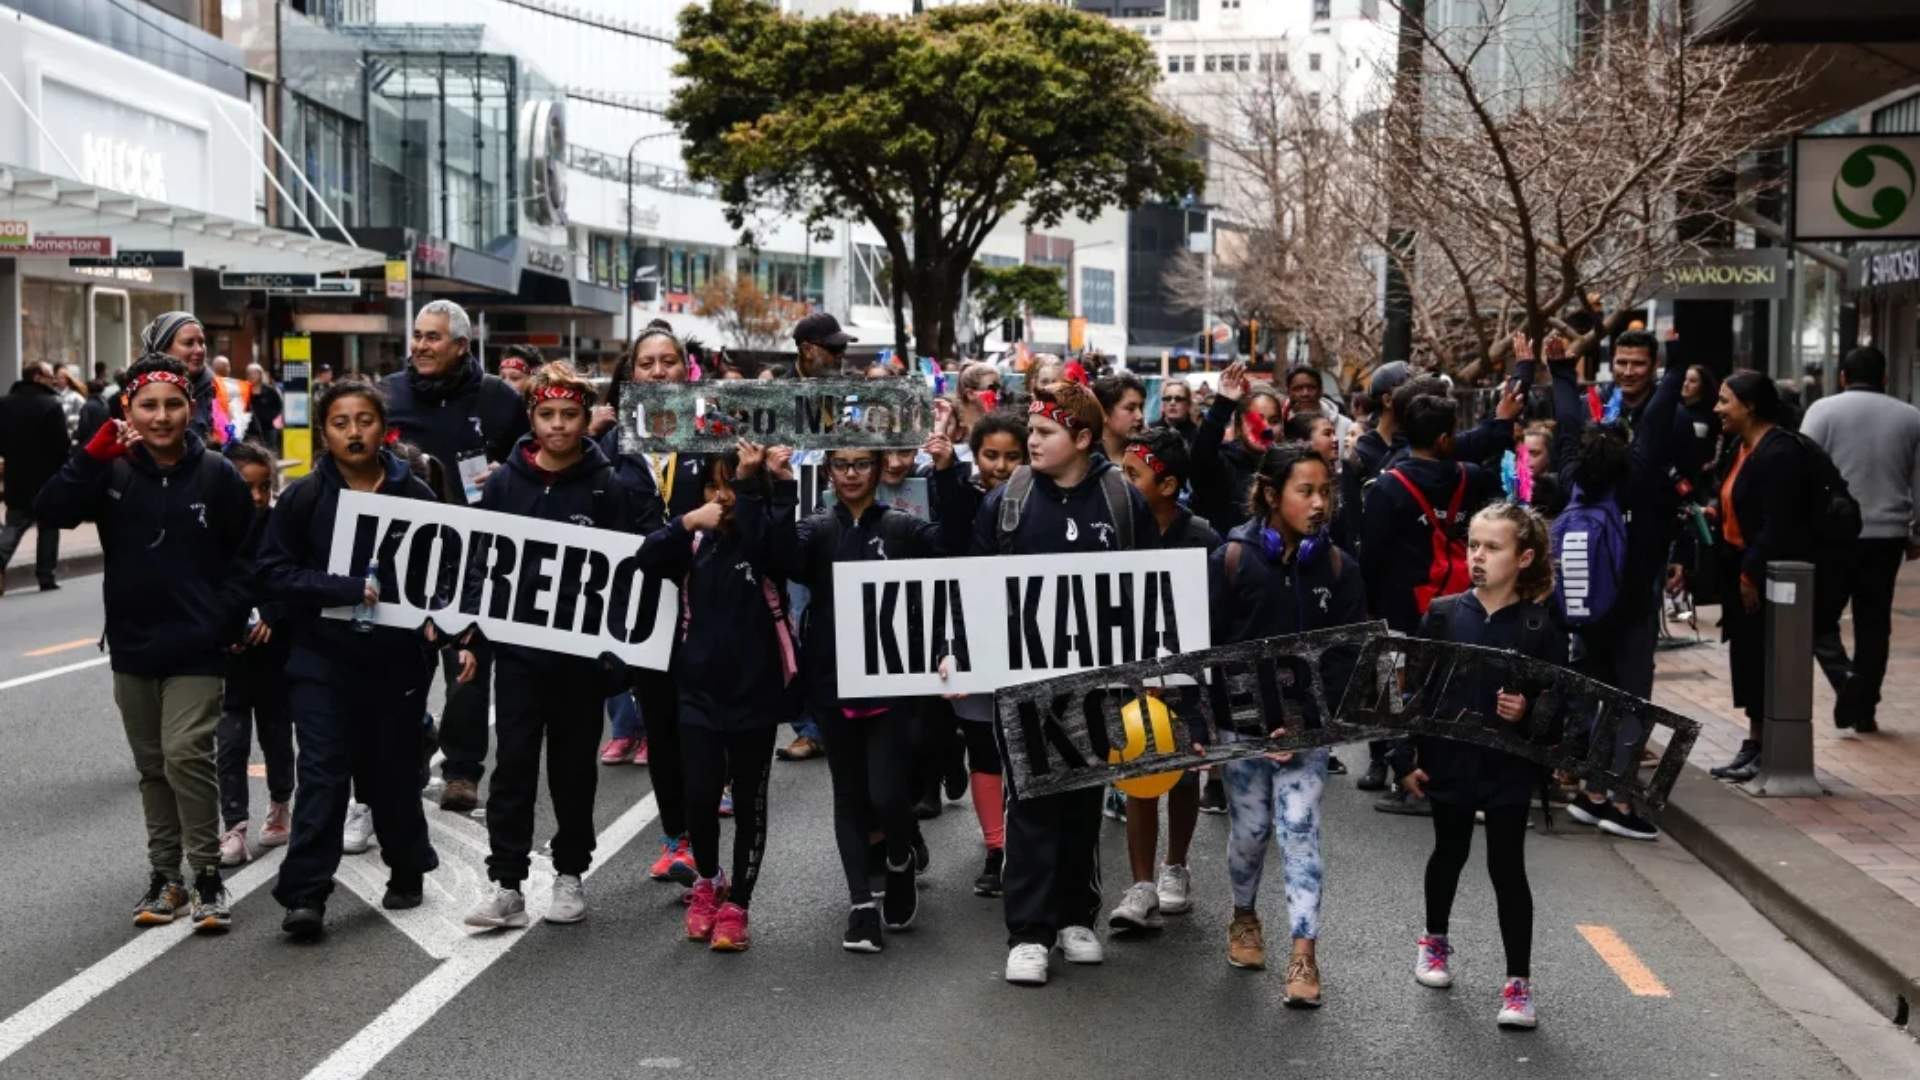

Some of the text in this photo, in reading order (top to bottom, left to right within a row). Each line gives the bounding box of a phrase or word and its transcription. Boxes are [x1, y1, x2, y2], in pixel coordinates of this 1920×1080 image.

[244, 275, 293, 286] MECCA
[1663, 264, 1776, 284] SWAROVSKI
[349, 513, 661, 645] KORERO
[1561, 531, 1590, 616] PUMA
[862, 570, 1181, 676] KIA KAHA
